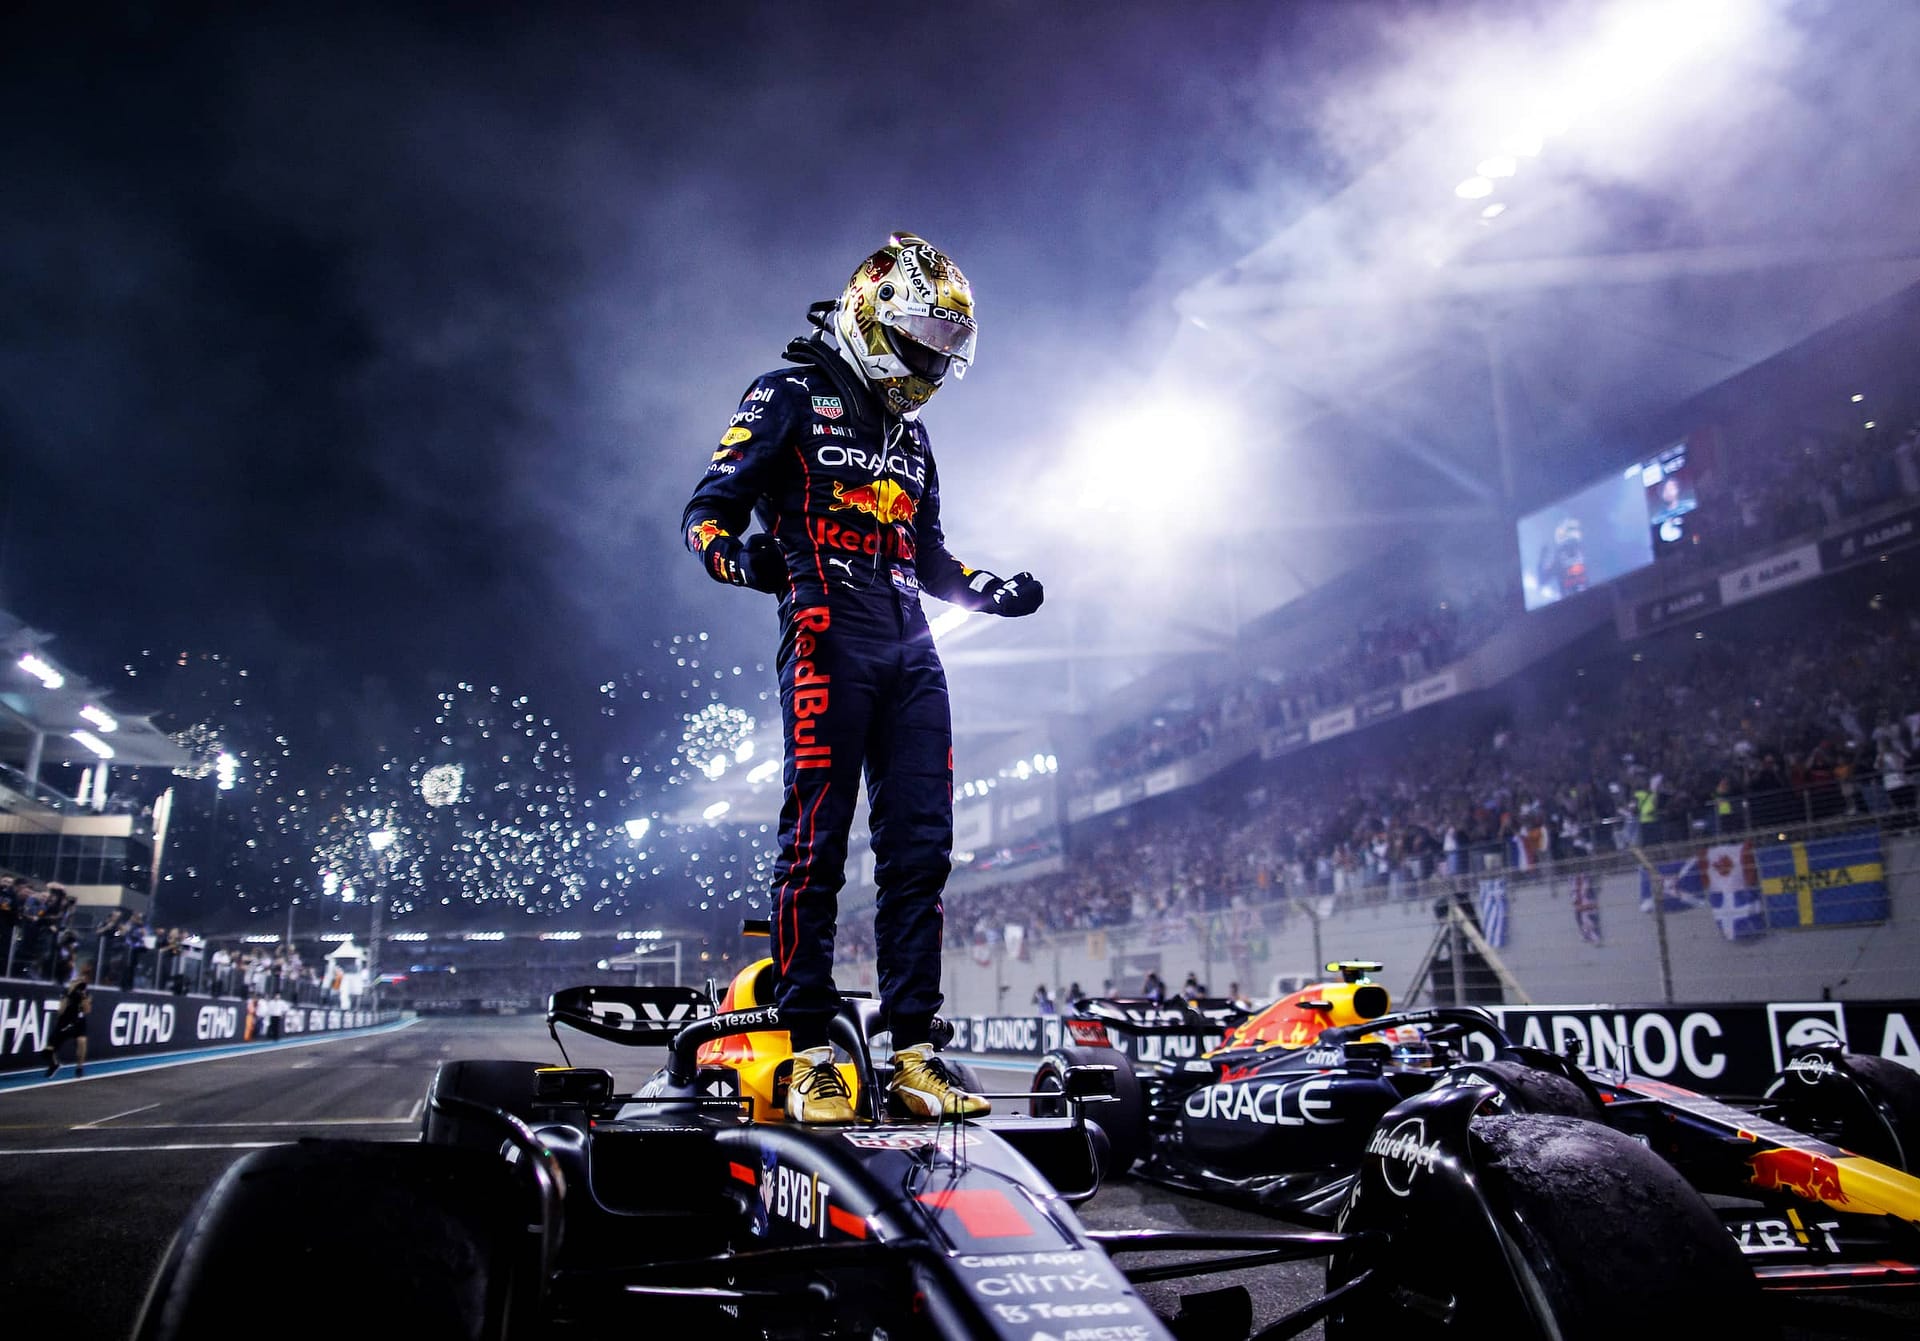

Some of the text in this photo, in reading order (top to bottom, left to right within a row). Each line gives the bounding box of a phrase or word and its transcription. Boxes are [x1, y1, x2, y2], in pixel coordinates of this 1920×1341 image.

[901, 249, 932, 299] CarNext
[814, 398, 840, 408] TAG
[812, 423, 846, 437] Mobil
[817, 445, 926, 489] ORACLE
[109, 1002, 176, 1047] ETIHAD
[196, 1005, 238, 1041] ETIHAD
[725, 1012, 763, 1027] Tezos
[986, 1018, 1038, 1050] ADNOC
[1523, 1012, 1726, 1079] ADNOC
[1185, 1079, 1345, 1126] ORACLE
[777, 1165, 831, 1239] BYBIT
[960, 1253, 1085, 1268] Cash App
[1030, 1302, 1131, 1319] Tezos
